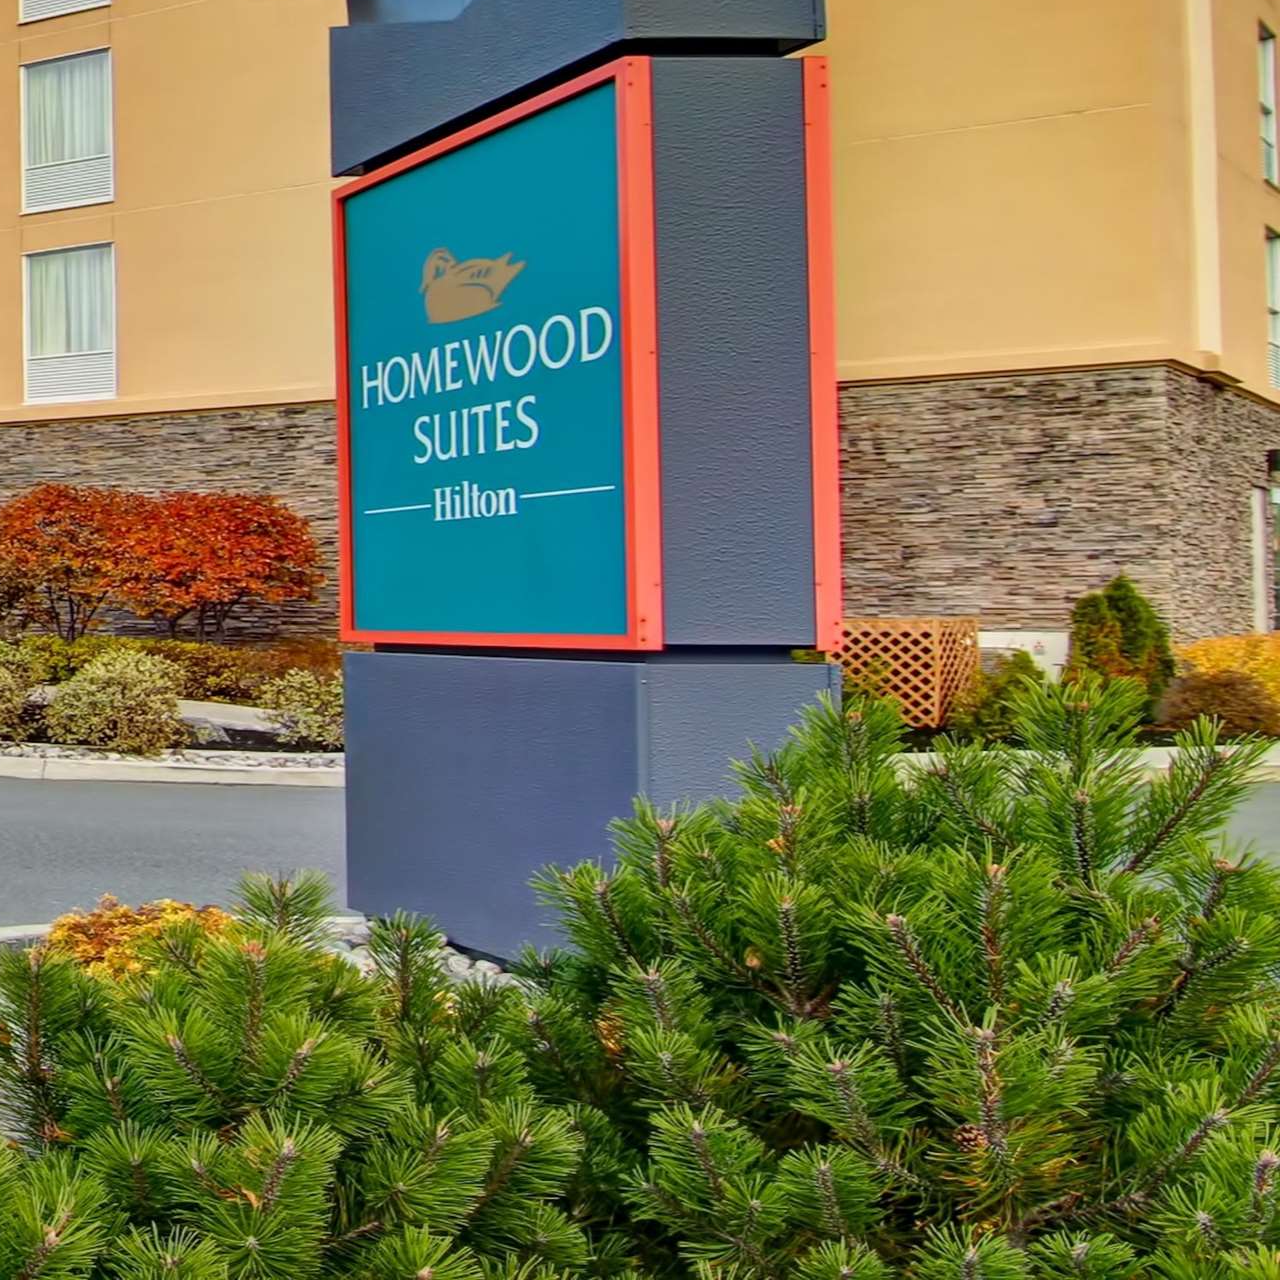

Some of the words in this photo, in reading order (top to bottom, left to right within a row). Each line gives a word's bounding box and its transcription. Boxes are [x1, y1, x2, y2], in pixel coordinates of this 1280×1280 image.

[361, 306, 614, 409] HOMEWOOD
[413, 395, 540, 465] SUITES
[433, 480, 517, 522] Hilton
